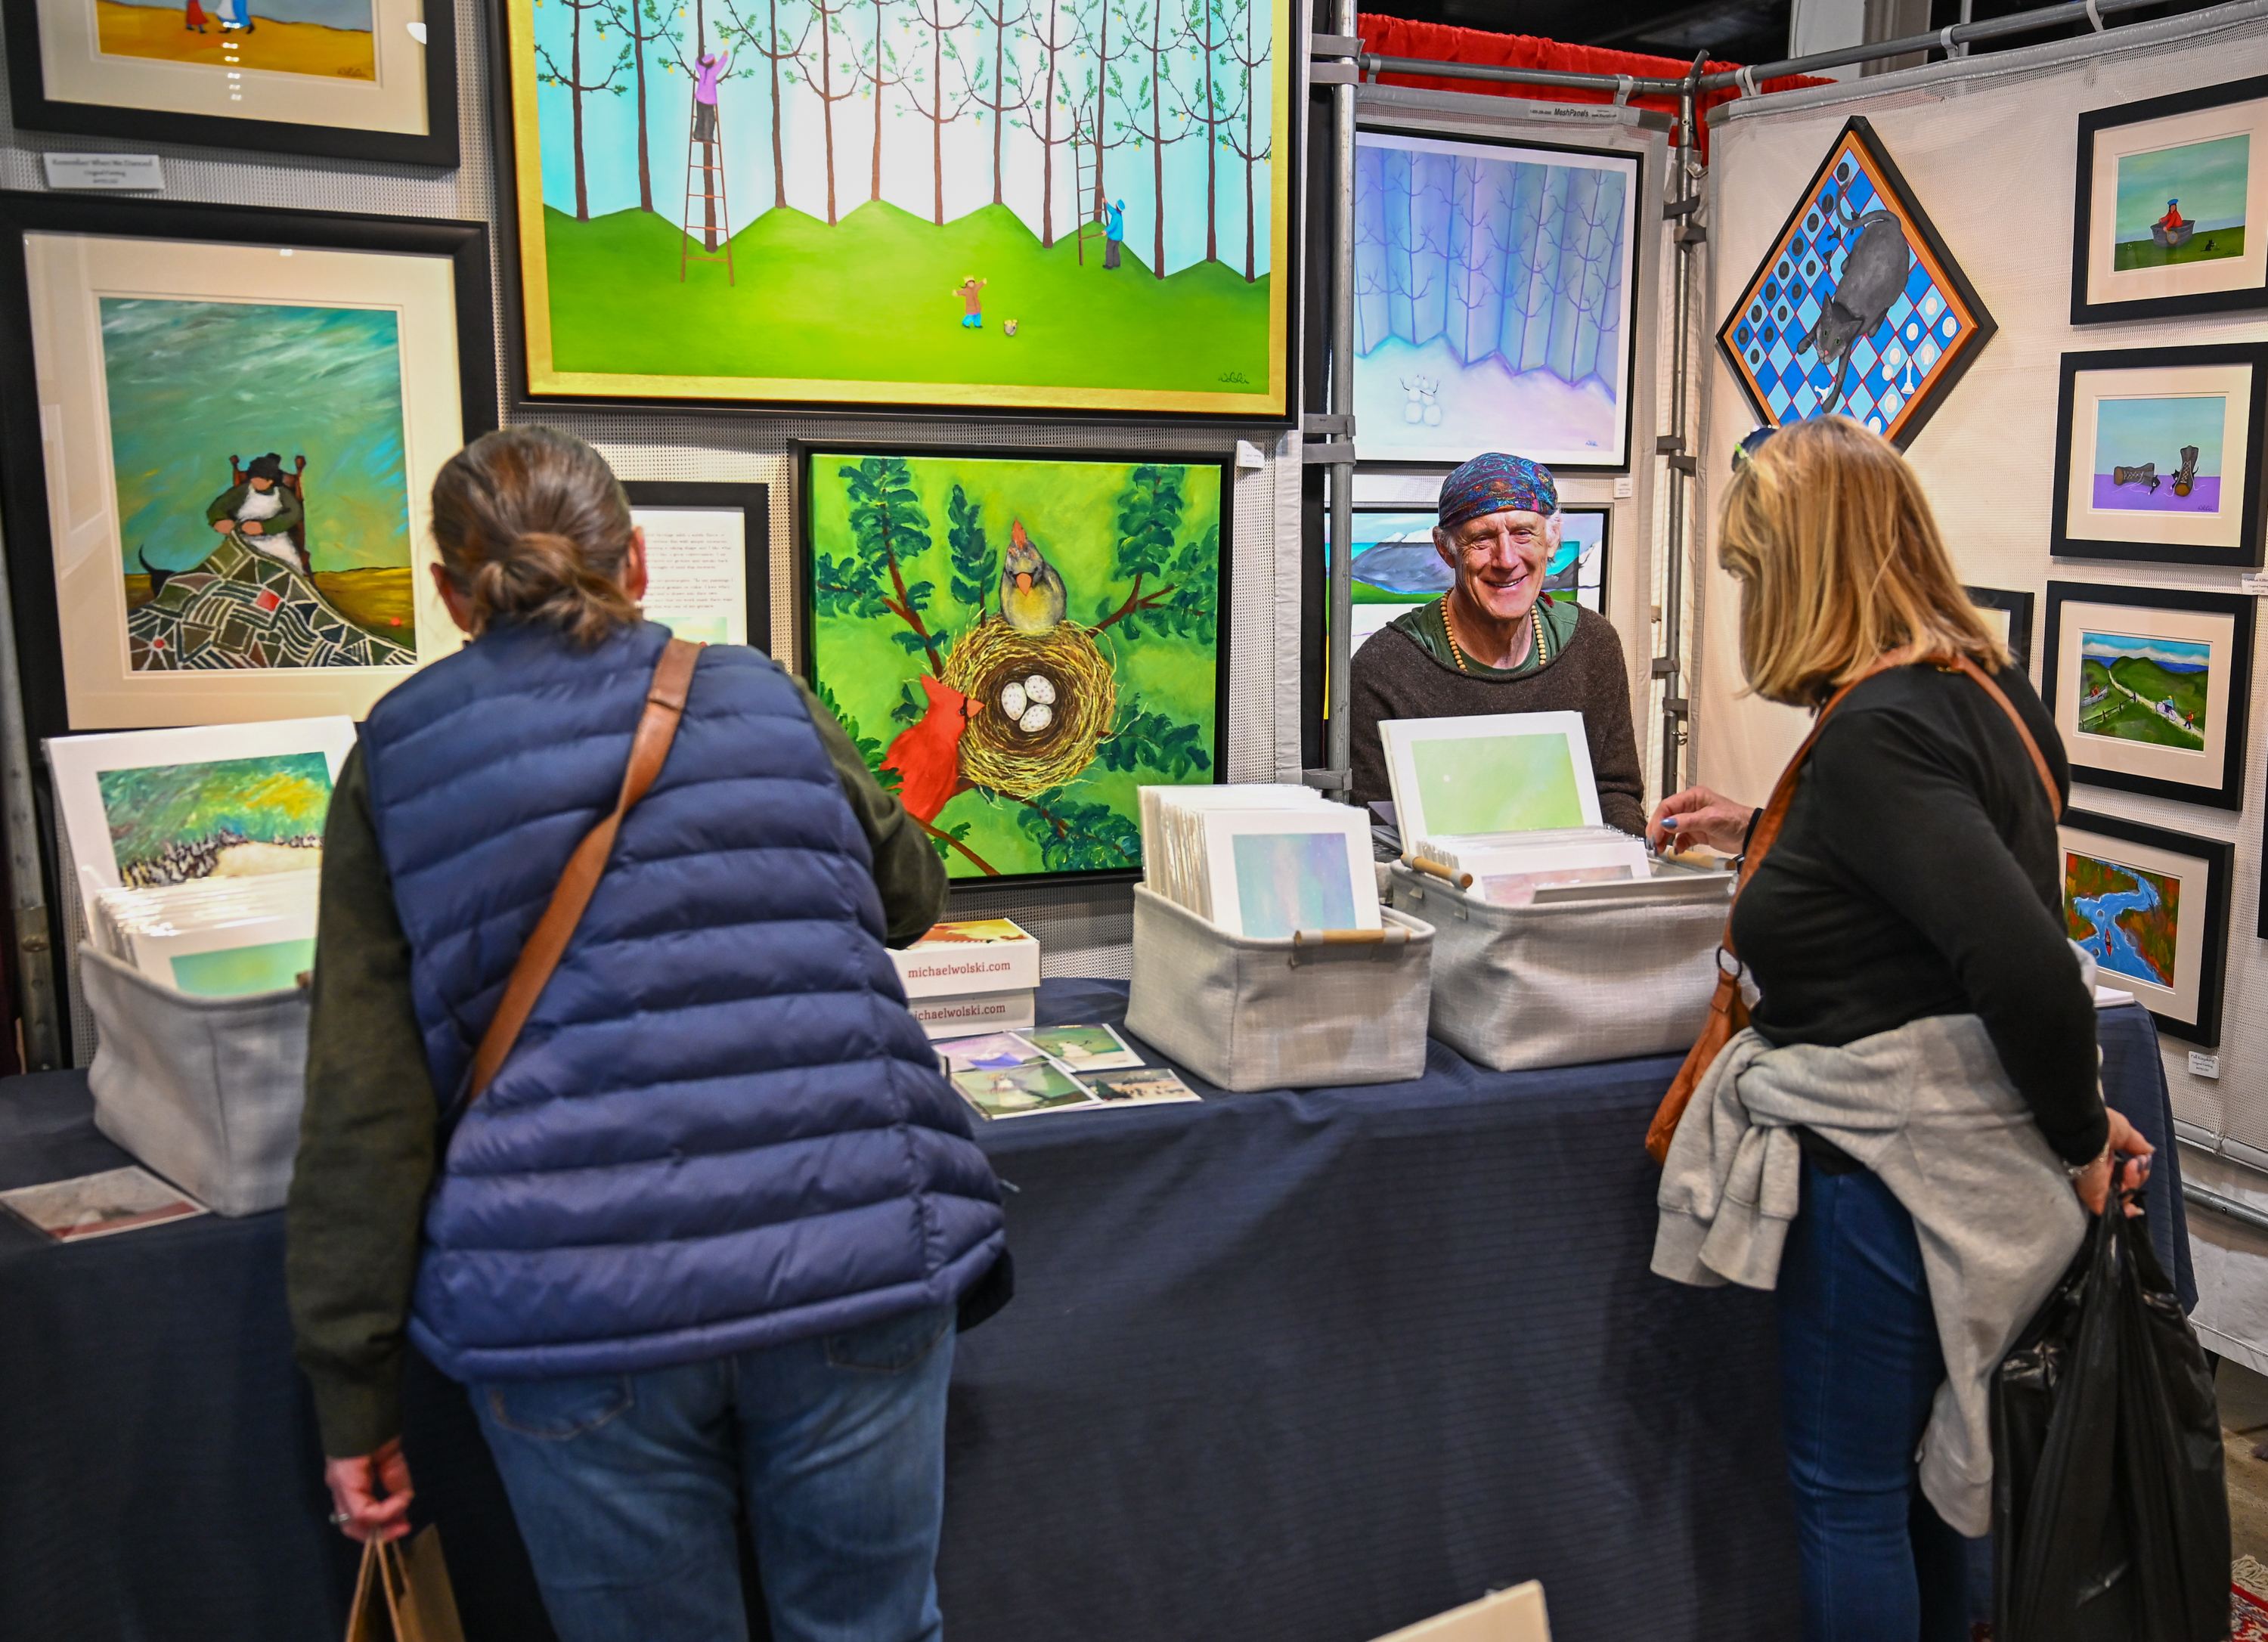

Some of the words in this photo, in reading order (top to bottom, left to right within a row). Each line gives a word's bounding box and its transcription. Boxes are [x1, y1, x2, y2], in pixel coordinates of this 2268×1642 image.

[1554, 107, 1589, 118] MeshPanels
[908, 962, 1011, 978] michaelwolski.com
[914, 1004, 1006, 1021] ichaelwolski.com
